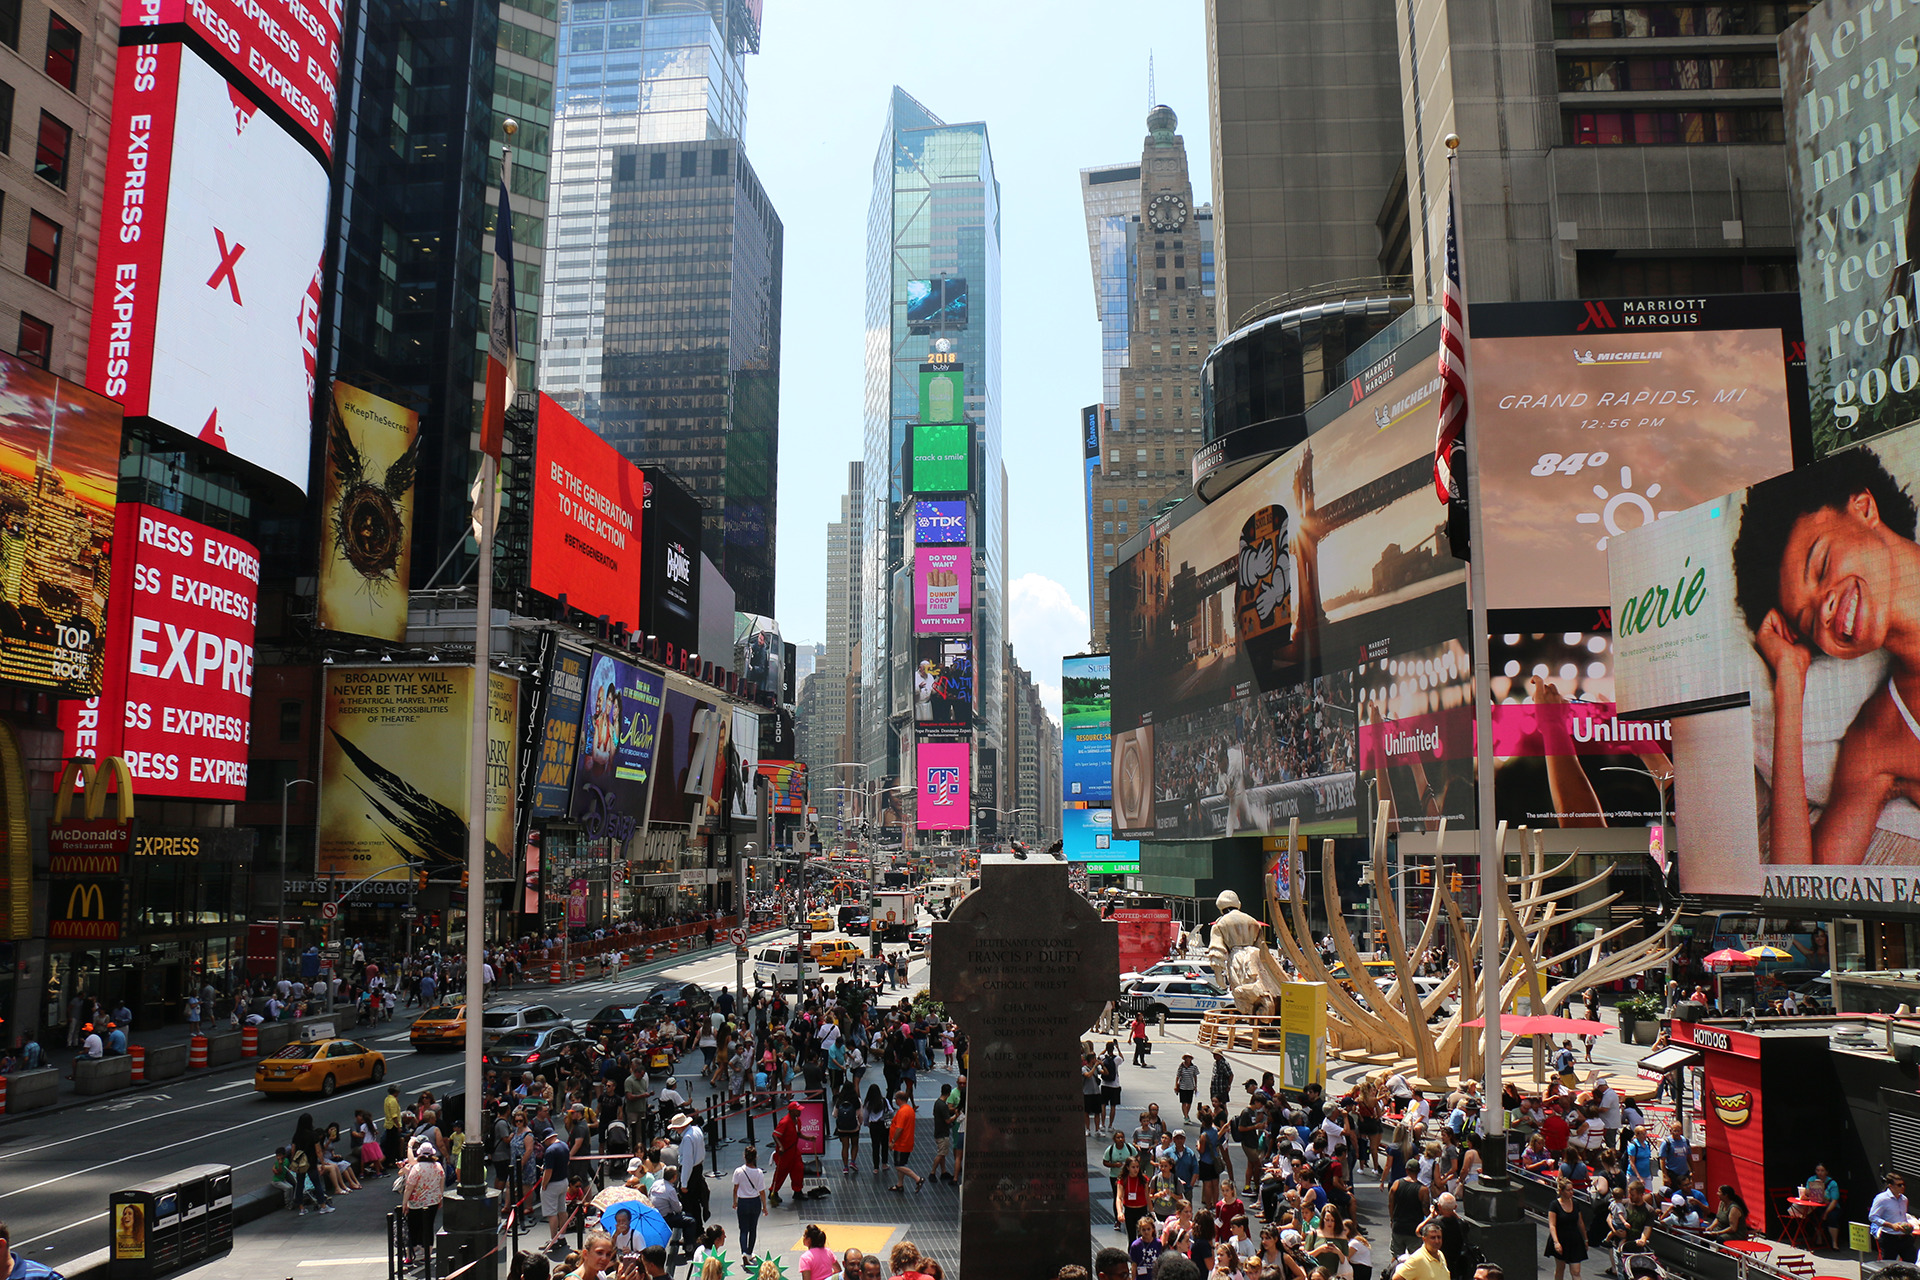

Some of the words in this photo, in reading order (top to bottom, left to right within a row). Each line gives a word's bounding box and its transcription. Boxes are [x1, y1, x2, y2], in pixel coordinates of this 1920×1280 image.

[249, 47, 320, 127] EXPRESS
[1804, 35, 1918, 139] bras
[120, 114, 151, 244] EXPRESS
[1815, 169, 1907, 261] you
[206, 225, 246, 307] X
[1820, 215, 1912, 304] feel
[1623, 299, 1707, 311] MARRIOTT
[1624, 313, 1699, 326] MARQUIS
[105, 263, 138, 397] EXPRESS
[927, 354, 956, 364] 2018
[1597, 351, 1663, 361] MICHELIN
[1364, 352, 1397, 381] MARRIOTT
[1365, 367, 1395, 393] MARQUIS
[1391, 375, 1441, 418] MICHELIN
[1498, 393, 1590, 410] GRAND
[1597, 389, 1700, 408] RAPIDS,
[1712, 388, 1749, 404] MI
[344, 402, 409, 433] #KeepTheSecrets
[1580, 418, 1632, 430] 12:56
[1638, 416, 1666, 428] PM
[915, 454, 935, 462] crack
[1197, 438, 1227, 461] MARRIOTT
[550, 461, 563, 485] BE
[565, 470, 582, 497] THE
[583, 483, 633, 532] GENERATION
[558, 493, 571, 516] TO
[573, 502, 595, 531] TAKE
[596, 522, 625, 550] ACTION
[929, 516, 962, 527] TDK
[564, 533, 618, 572] #BETHEGENERATION
[171, 575, 249, 620] EXPRESS
[1619, 556, 1707, 638] aerie
[55, 623, 90, 650] TOP
[1368, 637, 1391, 650] MARRIOTT
[54, 648, 67, 660] OF
[69, 650, 88, 664] THE
[52, 661, 88, 681] ROCK
[418, 672, 448, 683] WILL
[333, 685, 373, 696] NEVER
[376, 685, 389, 696] BE
[394, 684, 418, 695] THE
[422, 684, 457, 695] SAME.
[338, 706, 379, 715] REDEFINES
[381, 706, 396, 714] THE
[398, 706, 449, 714] POSSIBILITIES
[347, 697, 393, 705] THEATRICAL
[396, 697, 427, 705] MARVEL
[162, 707, 242, 742] EXPRESS
[367, 715, 378, 723] OF
[495, 707, 512, 725] PLAY
[546, 718, 577, 744] COME
[619, 712, 653, 749] Aladdin
[1573, 716, 1672, 743] Unlimit
[1385, 726, 1439, 757] Unlimited
[539, 760, 572, 787] AWAY
[50, 829, 127, 842] McDonald's
[63, 842, 113, 850] Restaurant
[134, 836, 200, 856] EXPRESS
[1114, 864, 1130, 872] LINE
[282, 880, 327, 894] GIFTS
[340, 882, 419, 896] LUGGAGE
[1763, 875, 1884, 902] AMERICAN
[975, 939, 1027, 948] LIEUTENANT
[1031, 938, 1074, 948] COLONEL
[968, 950, 1021, 962] FRANCIS
[1025, 950, 1033, 962] P
[1039, 950, 1084, 962] DUFFY
[983, 981, 1030, 990] CATHOLIC
[1034, 981, 1068, 990] PRIEST
[1003, 1003, 1048, 1012] CHAPLAIN
[1194, 1000, 1217, 1008] NYPD
[984, 1052, 991, 1061] A
[994, 1052, 1014, 1061] LIFE
[1032, 1052, 1069, 1061] SERVICE
[980, 1070, 1002, 1079] GOD
[1005, 1070, 1024, 1079] AND
[1028, 1070, 1072, 1079] COUNTRY
